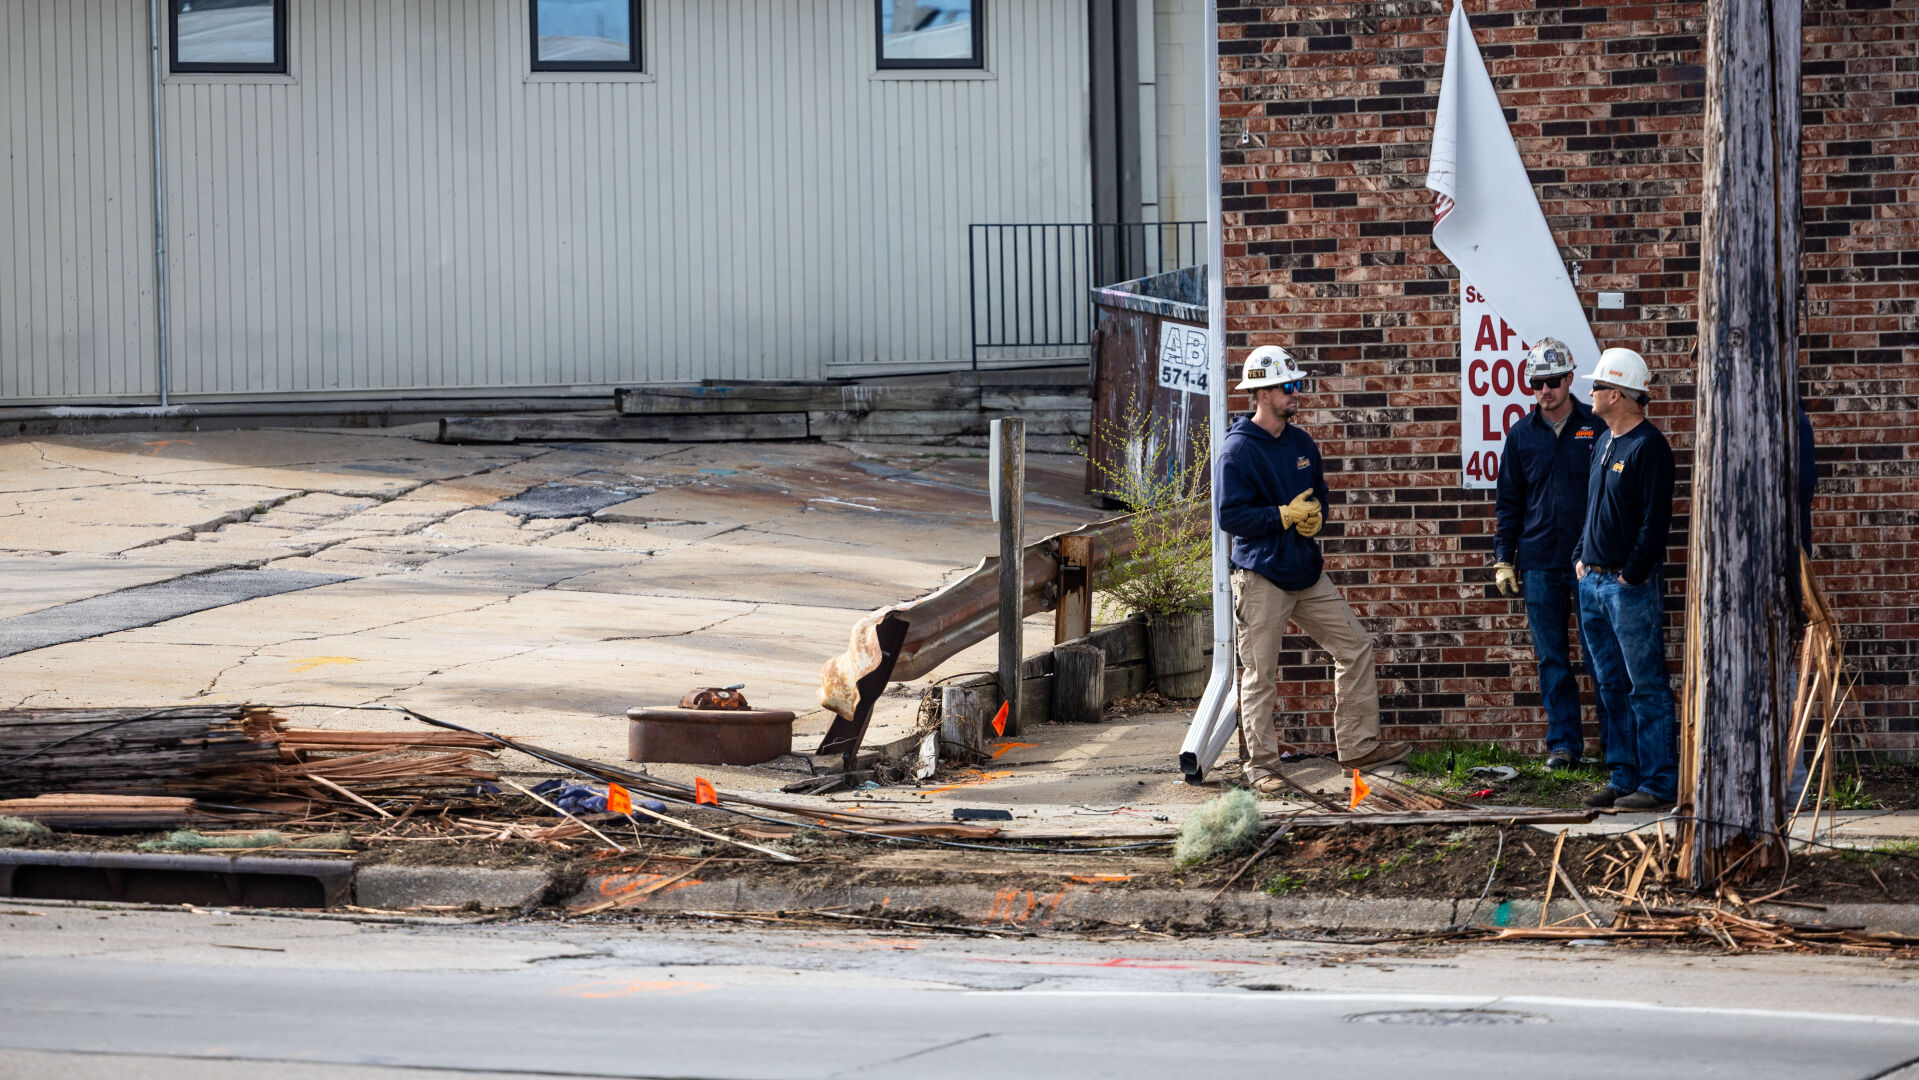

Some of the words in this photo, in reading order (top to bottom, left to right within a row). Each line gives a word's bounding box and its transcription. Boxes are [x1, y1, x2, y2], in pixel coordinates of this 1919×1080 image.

[1162, 327, 1209, 369] AB
[1248, 369, 1265, 378] YETI
[1482, 403, 1536, 441] LO
[1466, 451, 1502, 481] 40
